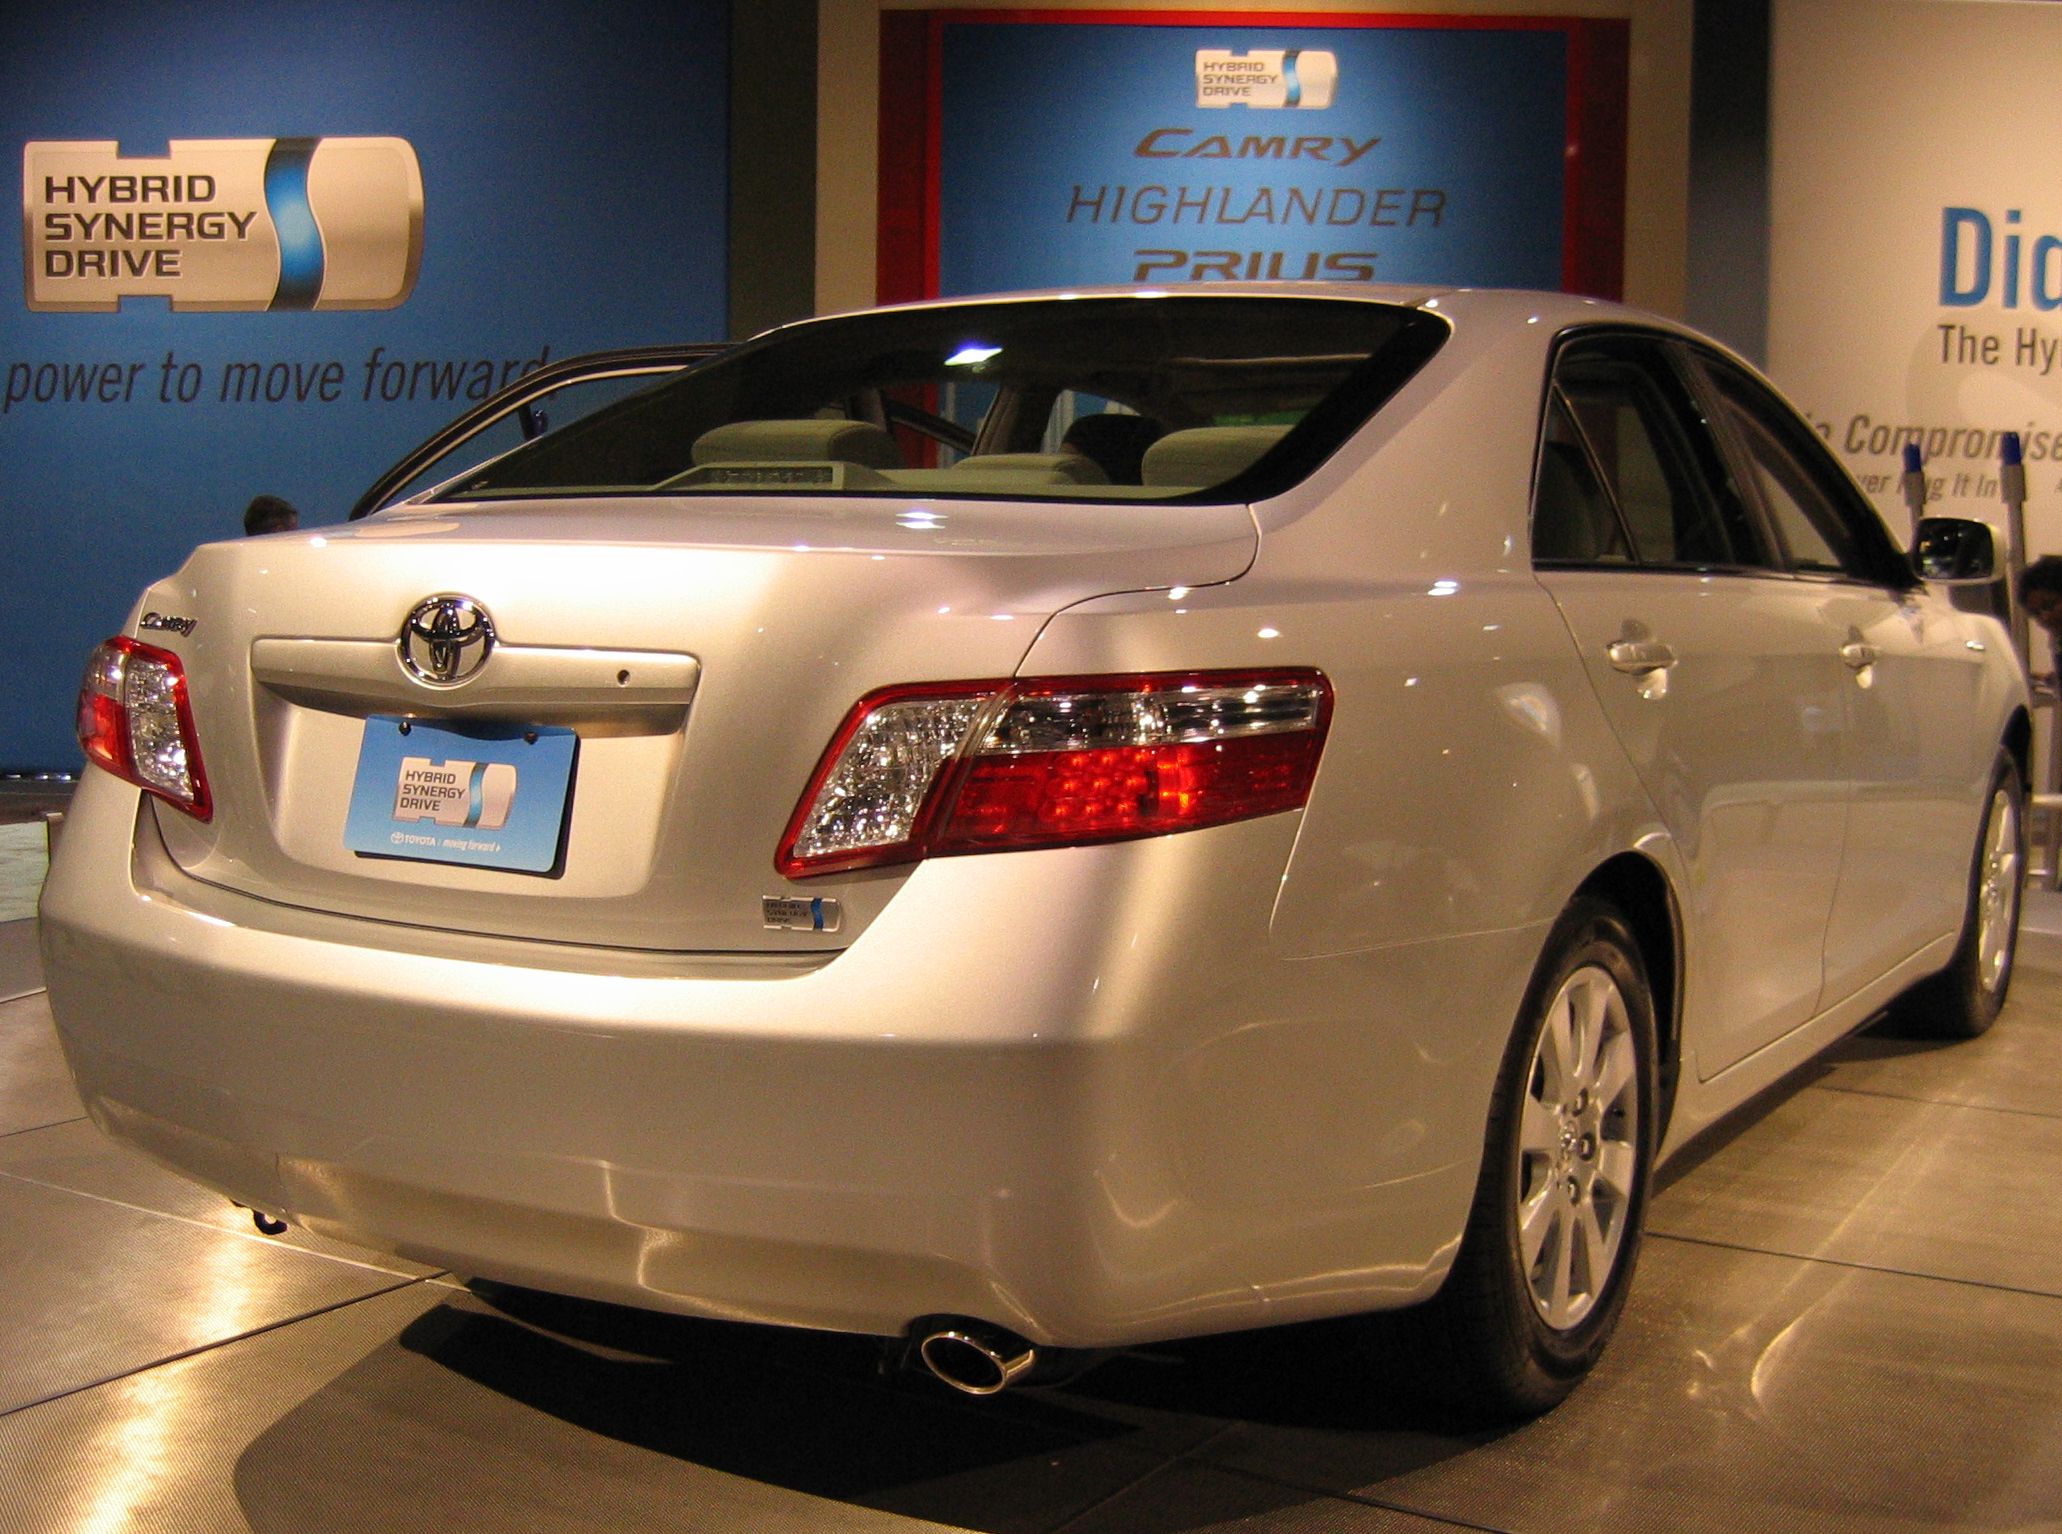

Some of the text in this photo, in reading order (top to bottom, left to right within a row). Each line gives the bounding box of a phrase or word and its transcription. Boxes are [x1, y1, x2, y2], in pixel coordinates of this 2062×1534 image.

[1202, 74, 1278, 85] SYNERGY
[1203, 61, 1264, 72] HYBRID
[1202, 86, 1251, 97] DRIVE
[1134, 128, 1382, 166] CAMRY
[44, 175, 216, 203] HYBRID
[1066, 184, 1447, 227] HIGHLANDER
[44, 211, 257, 241] SYNERGY
[44, 249, 181, 278] DRIVE
[1133, 249, 1379, 281] PRIUS
[1937, 324, 2062, 376] The Hy
[3, 362, 147, 414] power
[160, 350, 202, 402] to
[220, 360, 344, 402] move
[405, 770, 456, 784] HYBRID
[400, 798, 441, 812] DRIVE
[402, 784, 466, 800] SYNERGY
[404, 834, 436, 846] TOYOTA
